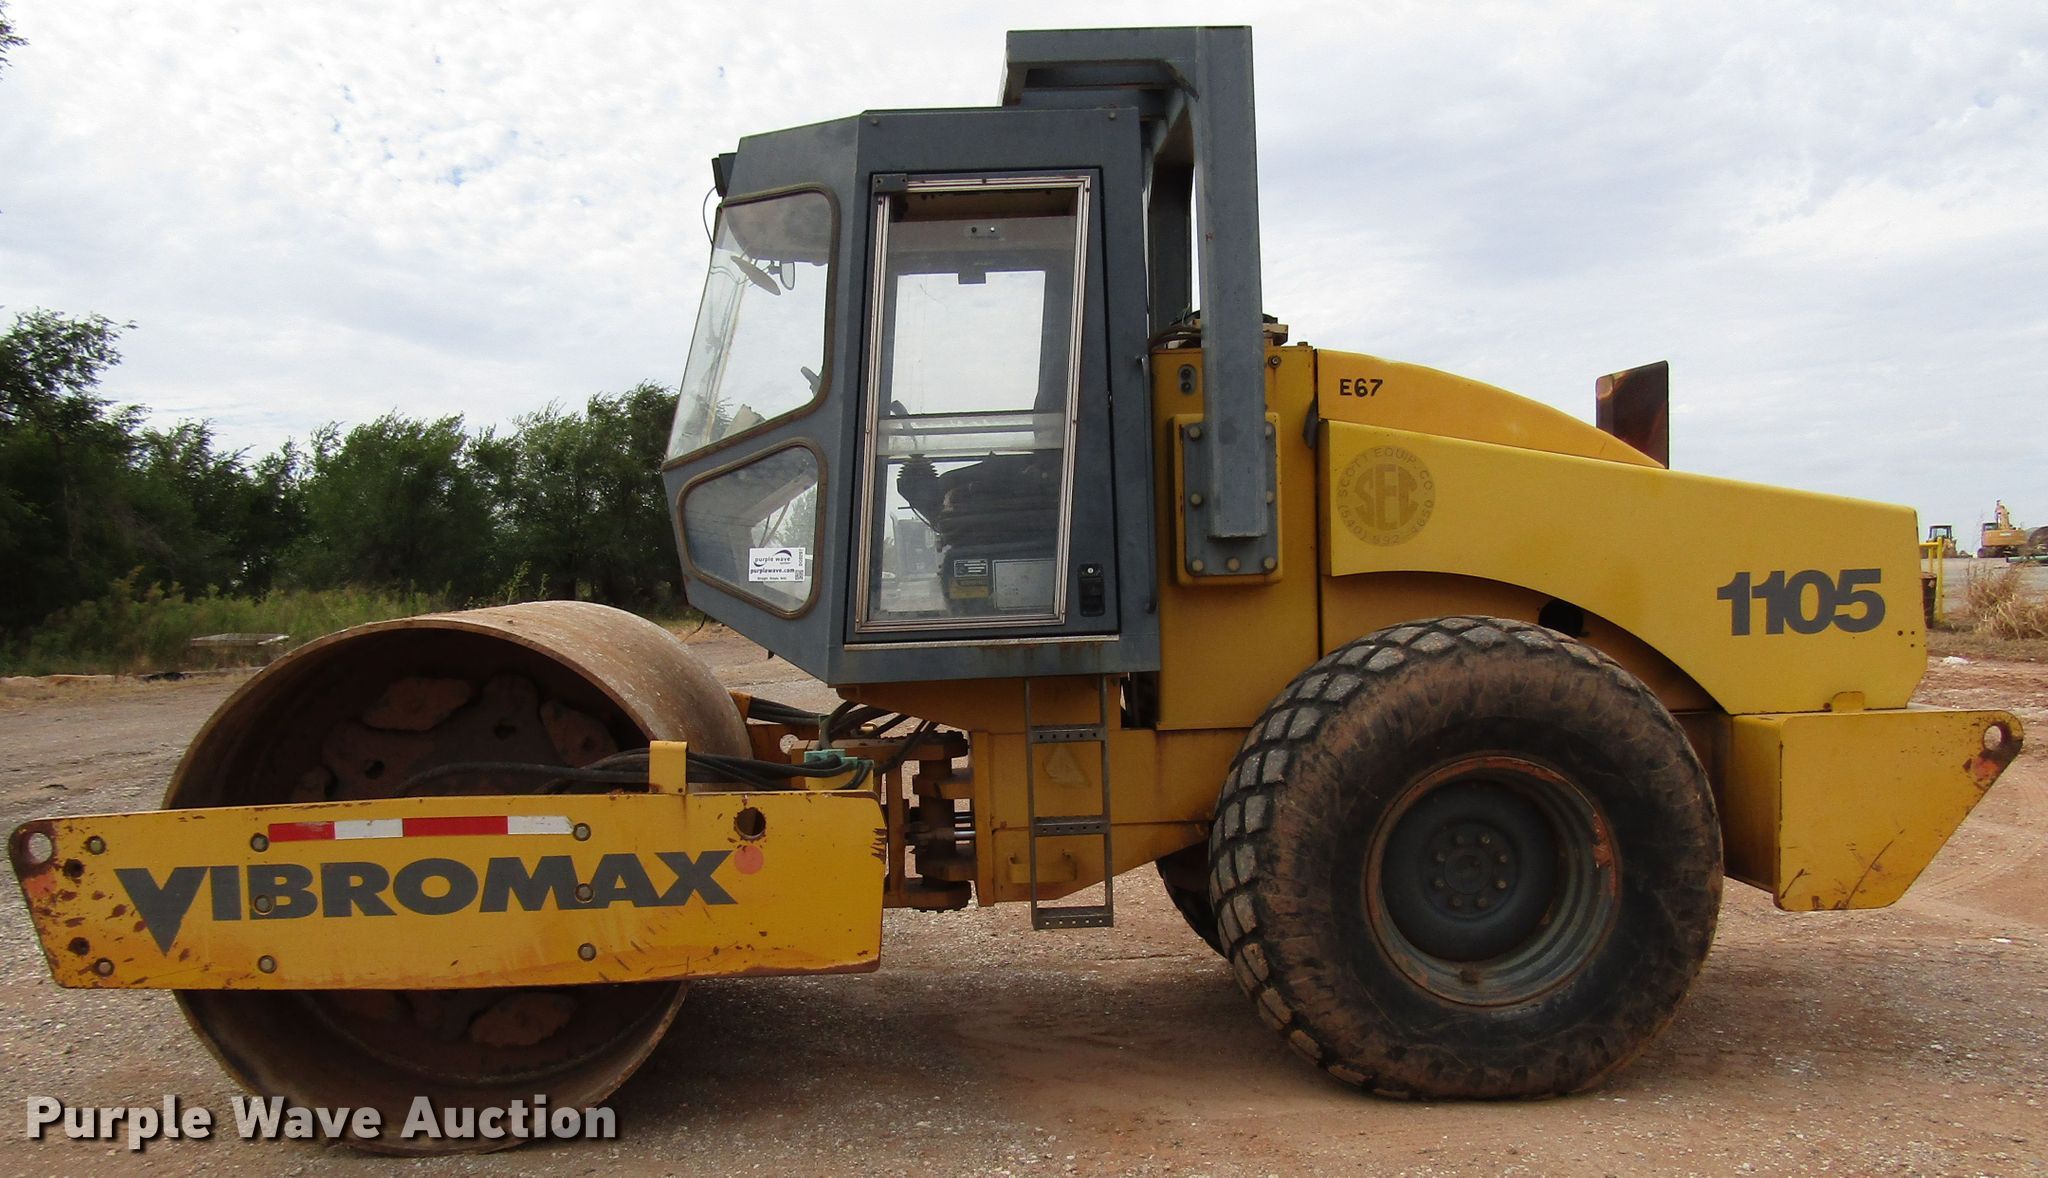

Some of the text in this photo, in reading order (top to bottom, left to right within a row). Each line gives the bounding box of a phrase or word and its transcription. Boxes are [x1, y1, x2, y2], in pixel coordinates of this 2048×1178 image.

[1339, 378, 1383, 398] E67
[1337, 455, 1368, 497] SCOTT
[1717, 568, 1886, 636] 1105
[114, 850, 738, 955] VIBROMAX
